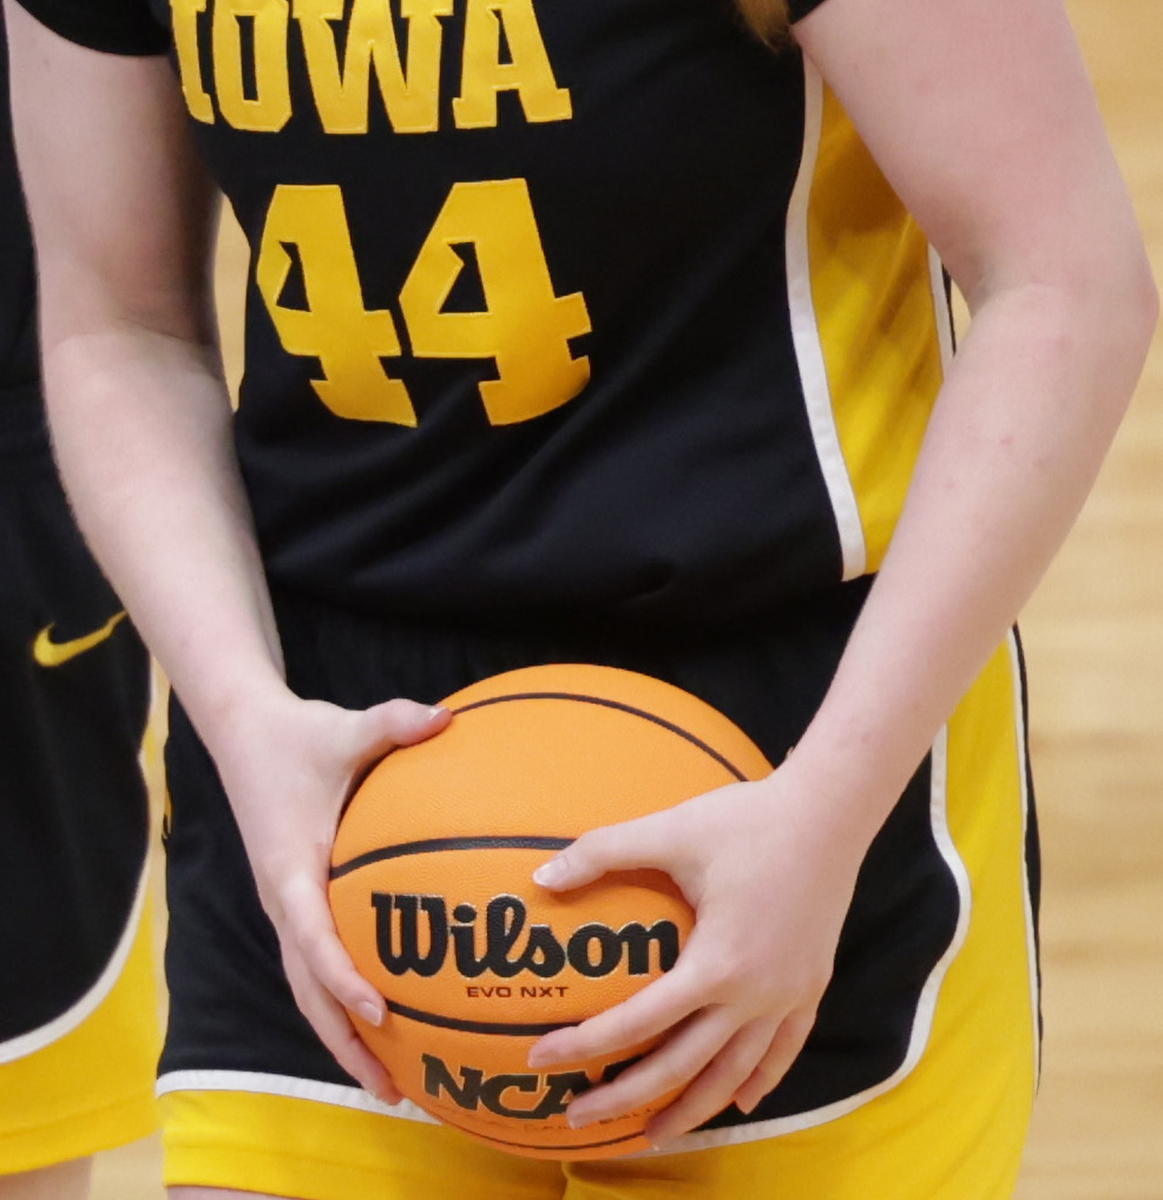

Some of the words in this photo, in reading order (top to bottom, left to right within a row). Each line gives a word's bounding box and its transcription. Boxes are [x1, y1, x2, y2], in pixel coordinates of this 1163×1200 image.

[256, 177, 592, 428] 44
[371, 891, 680, 979] Wilson
[466, 986, 512, 998] EVO
[520, 986, 569, 998] NXT
[421, 1053, 645, 1120] NCA
